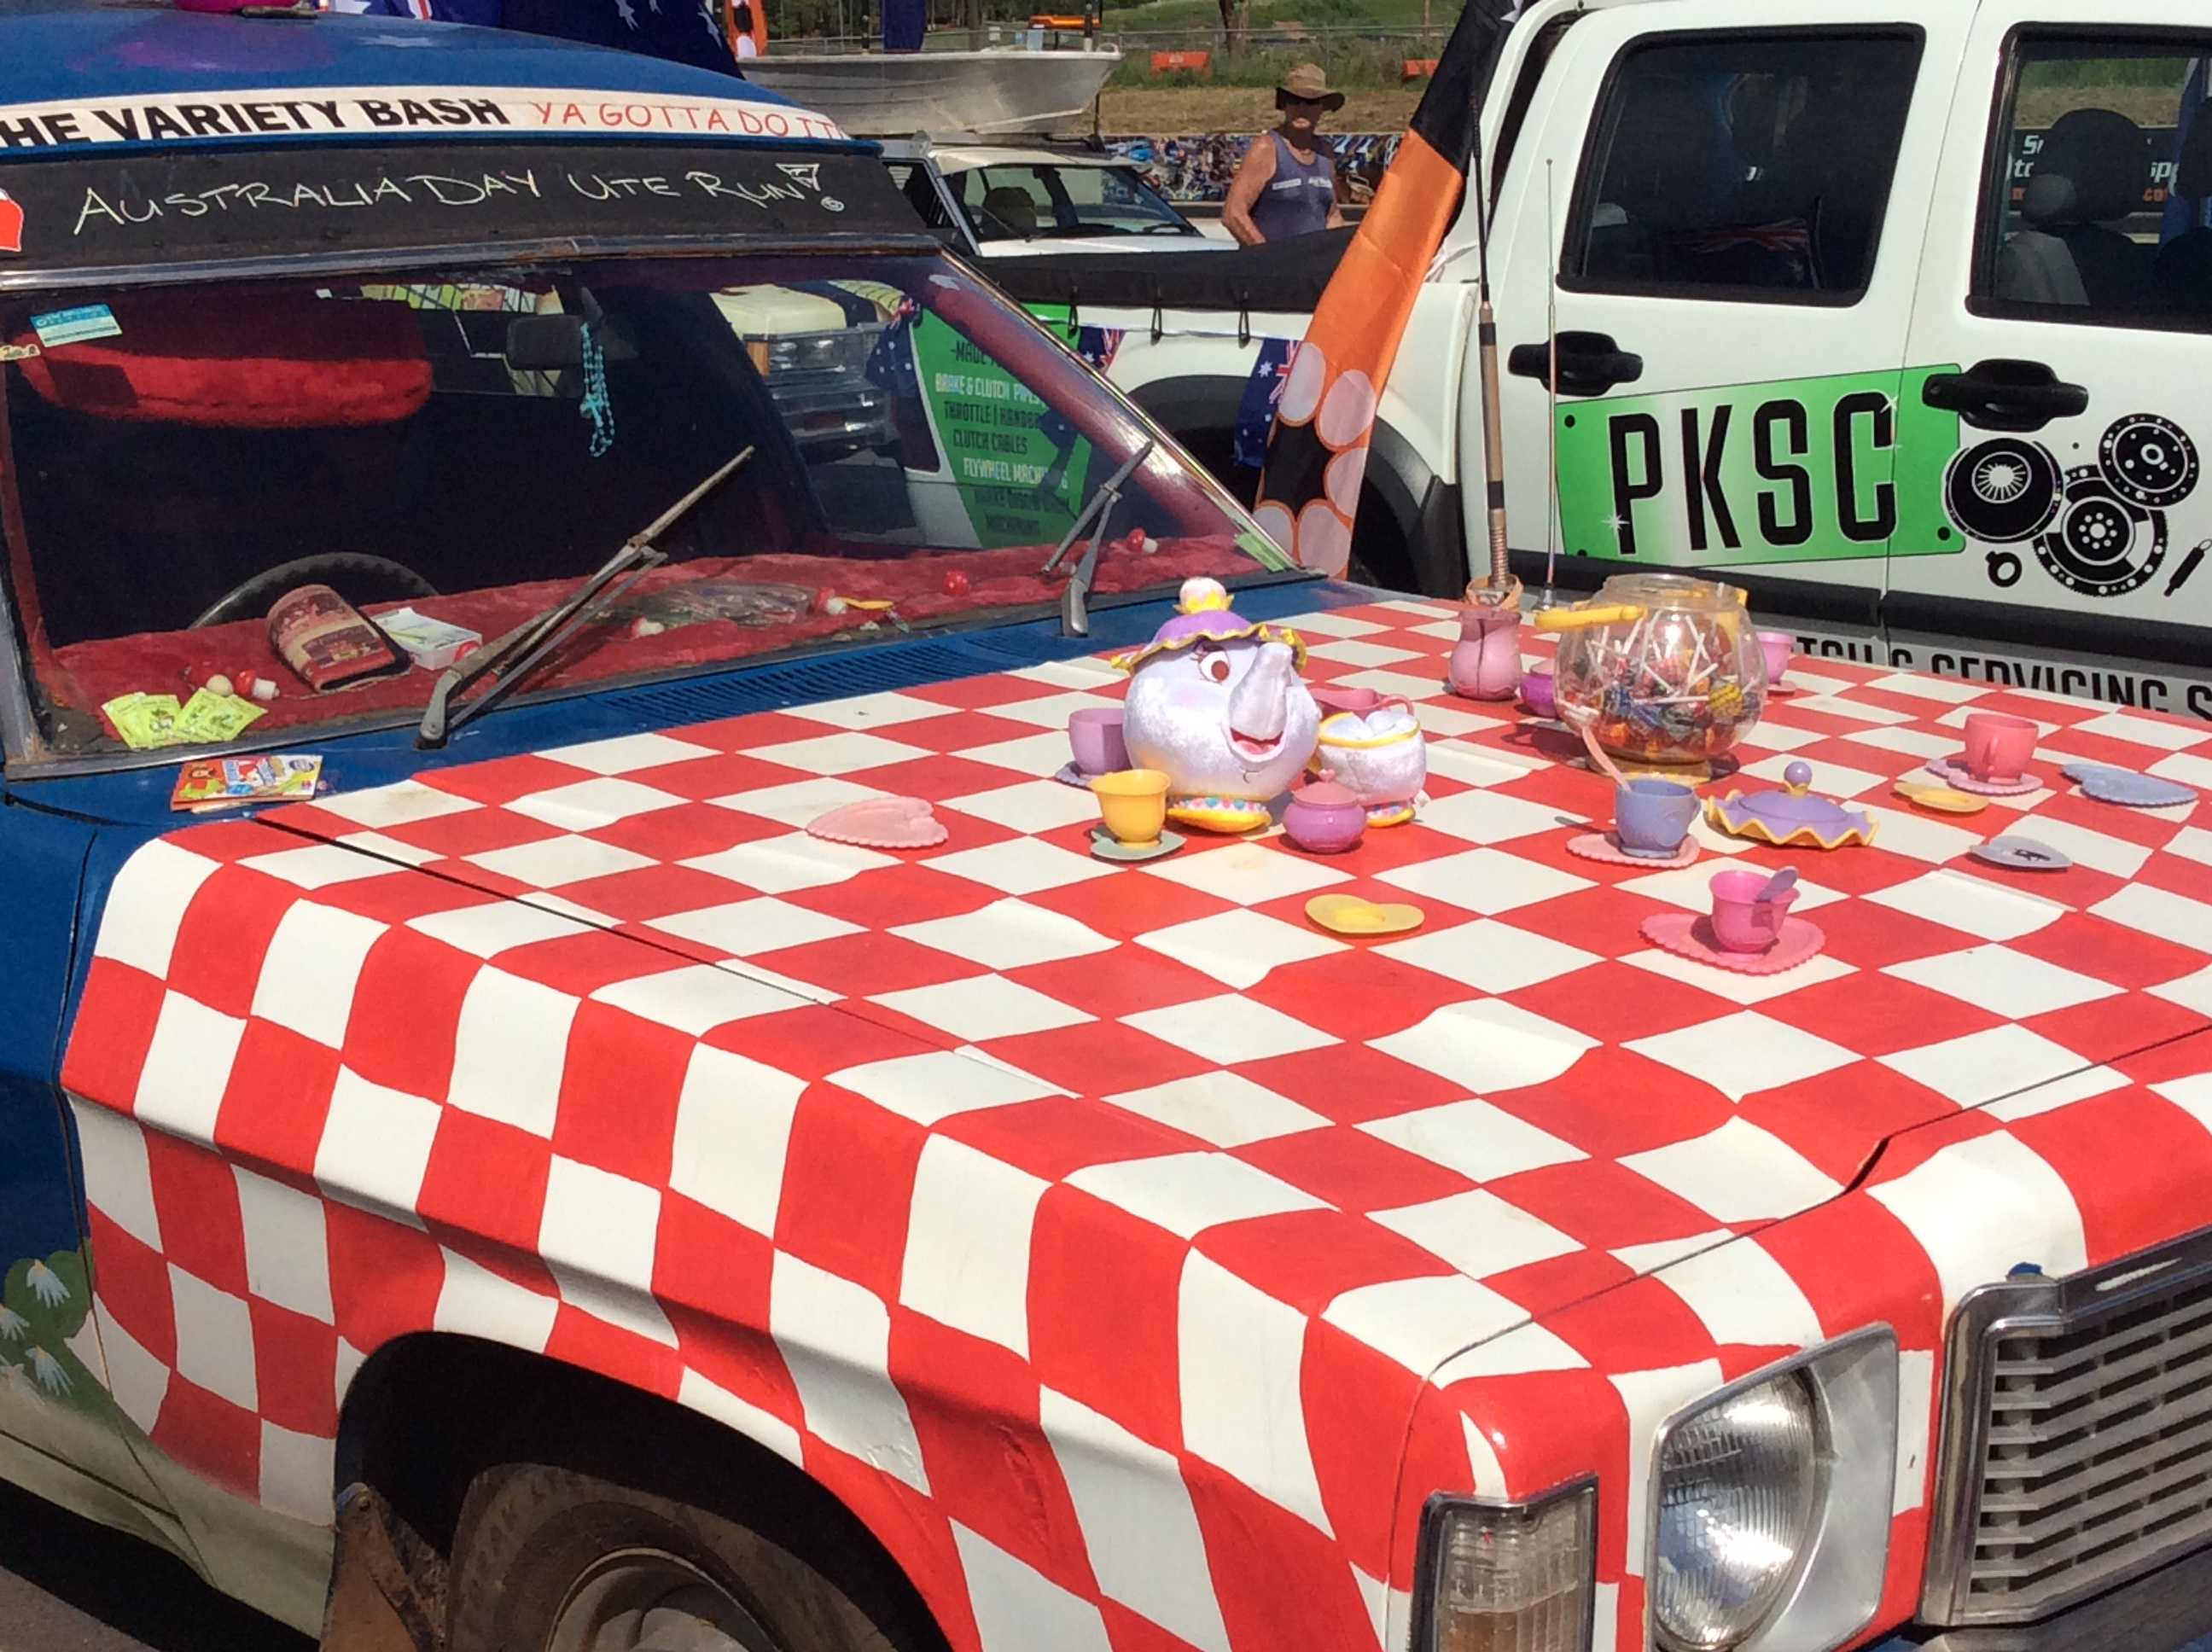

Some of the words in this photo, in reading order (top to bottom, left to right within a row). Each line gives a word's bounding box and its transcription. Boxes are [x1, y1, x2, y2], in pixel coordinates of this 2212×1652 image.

[90, 101, 347, 142] VARIETY
[352, 99, 510, 126] BASH
[528, 102, 586, 125] YA
[599, 102, 730, 131] GOTTA
[740, 109, 789, 137] DO
[568, 173, 682, 200] UTE
[975, 378, 1010, 401] CLUTCH
[944, 400, 991, 424] THROTTLE
[952, 428, 989, 451] CLUTCH
[991, 433, 1027, 454] CABLES
[963, 457, 1011, 481] FLYWHEEL
[1608, 391, 1898, 556] PKSC
